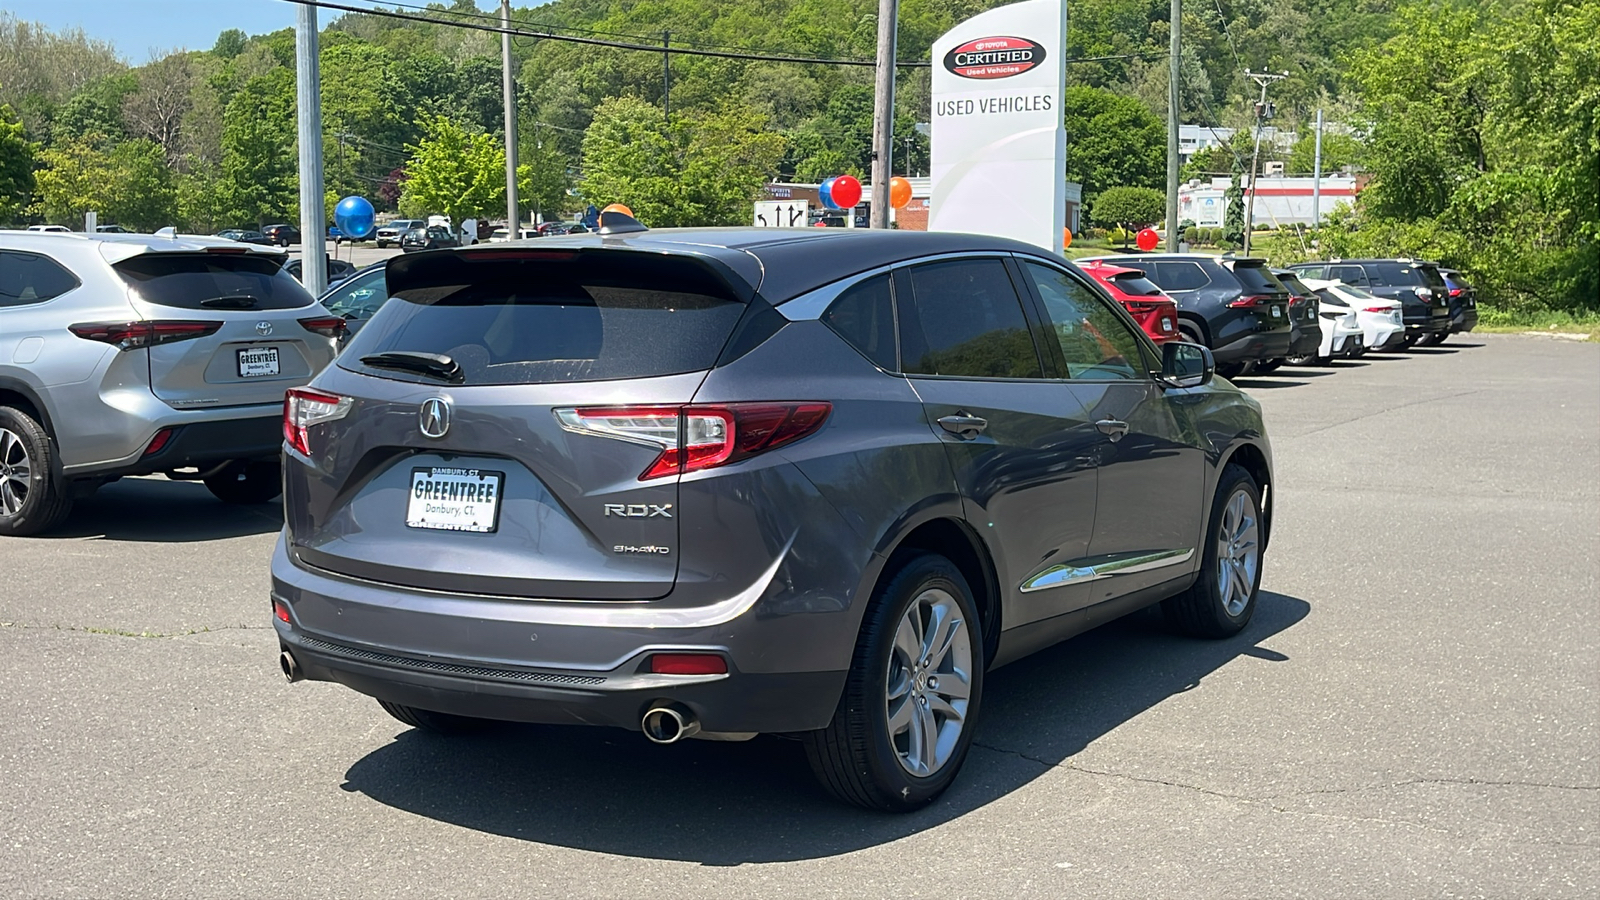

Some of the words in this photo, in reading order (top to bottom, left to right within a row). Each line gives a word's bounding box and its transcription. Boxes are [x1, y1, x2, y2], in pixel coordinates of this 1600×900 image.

[955, 50, 1033, 65] CERTIFIED
[966, 68, 985, 76] Used
[987, 66, 1020, 74] Vehicles
[937, 99, 975, 116] USED
[979, 95, 1052, 113] VEHICLES
[240, 353, 277, 364] GREENTREE
[431, 467, 467, 477] DANBURY,
[414, 479, 494, 503] GREENTREE
[425, 503, 461, 517] Danbury,
[463, 505, 475, 516] CT.
[604, 503, 673, 518] RDX
[408, 522, 489, 532] GREENTREE
[613, 545, 670, 554] SH-AWD
